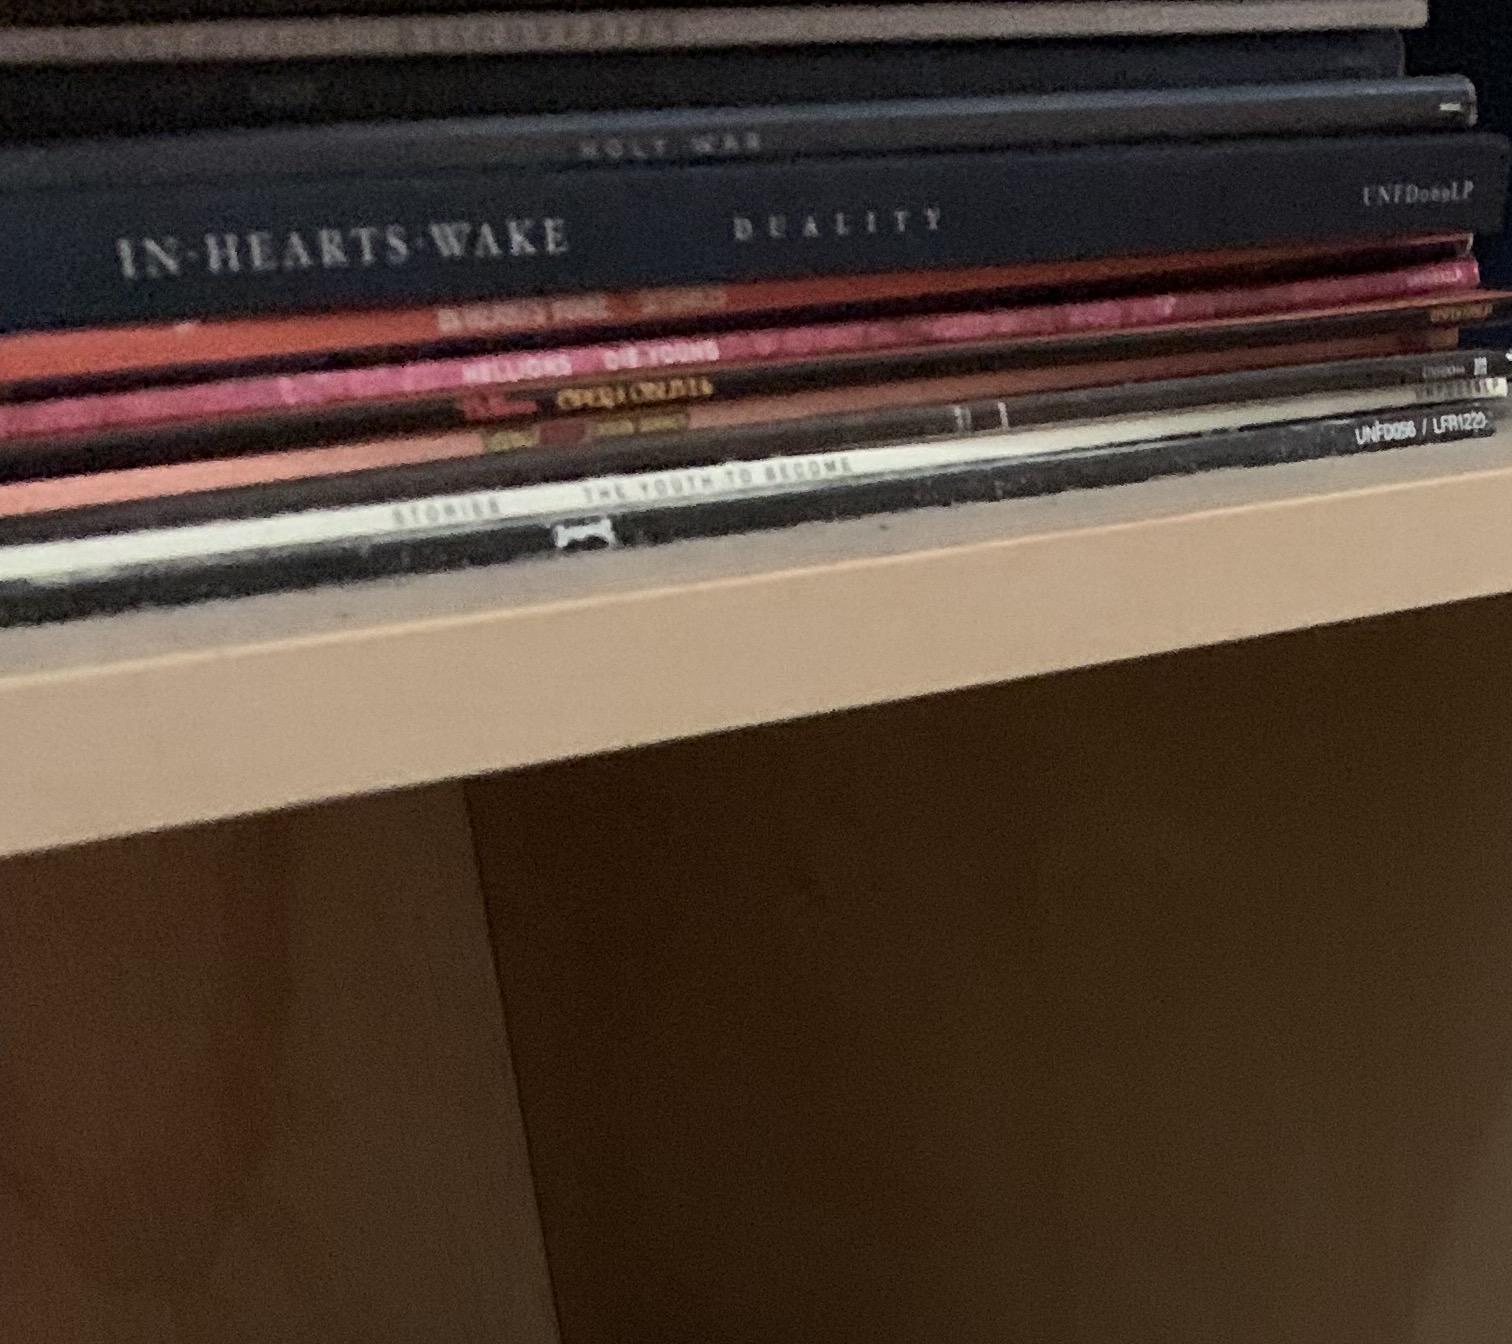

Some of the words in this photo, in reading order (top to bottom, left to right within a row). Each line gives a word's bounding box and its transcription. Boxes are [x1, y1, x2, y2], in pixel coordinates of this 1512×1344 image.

[733, 206, 942, 243] DUALITY
[584, 478, 631, 503] THE
[638, 468, 715, 498] YOUTH
[726, 463, 755, 489] TO
[764, 456, 853, 486] BECOME
